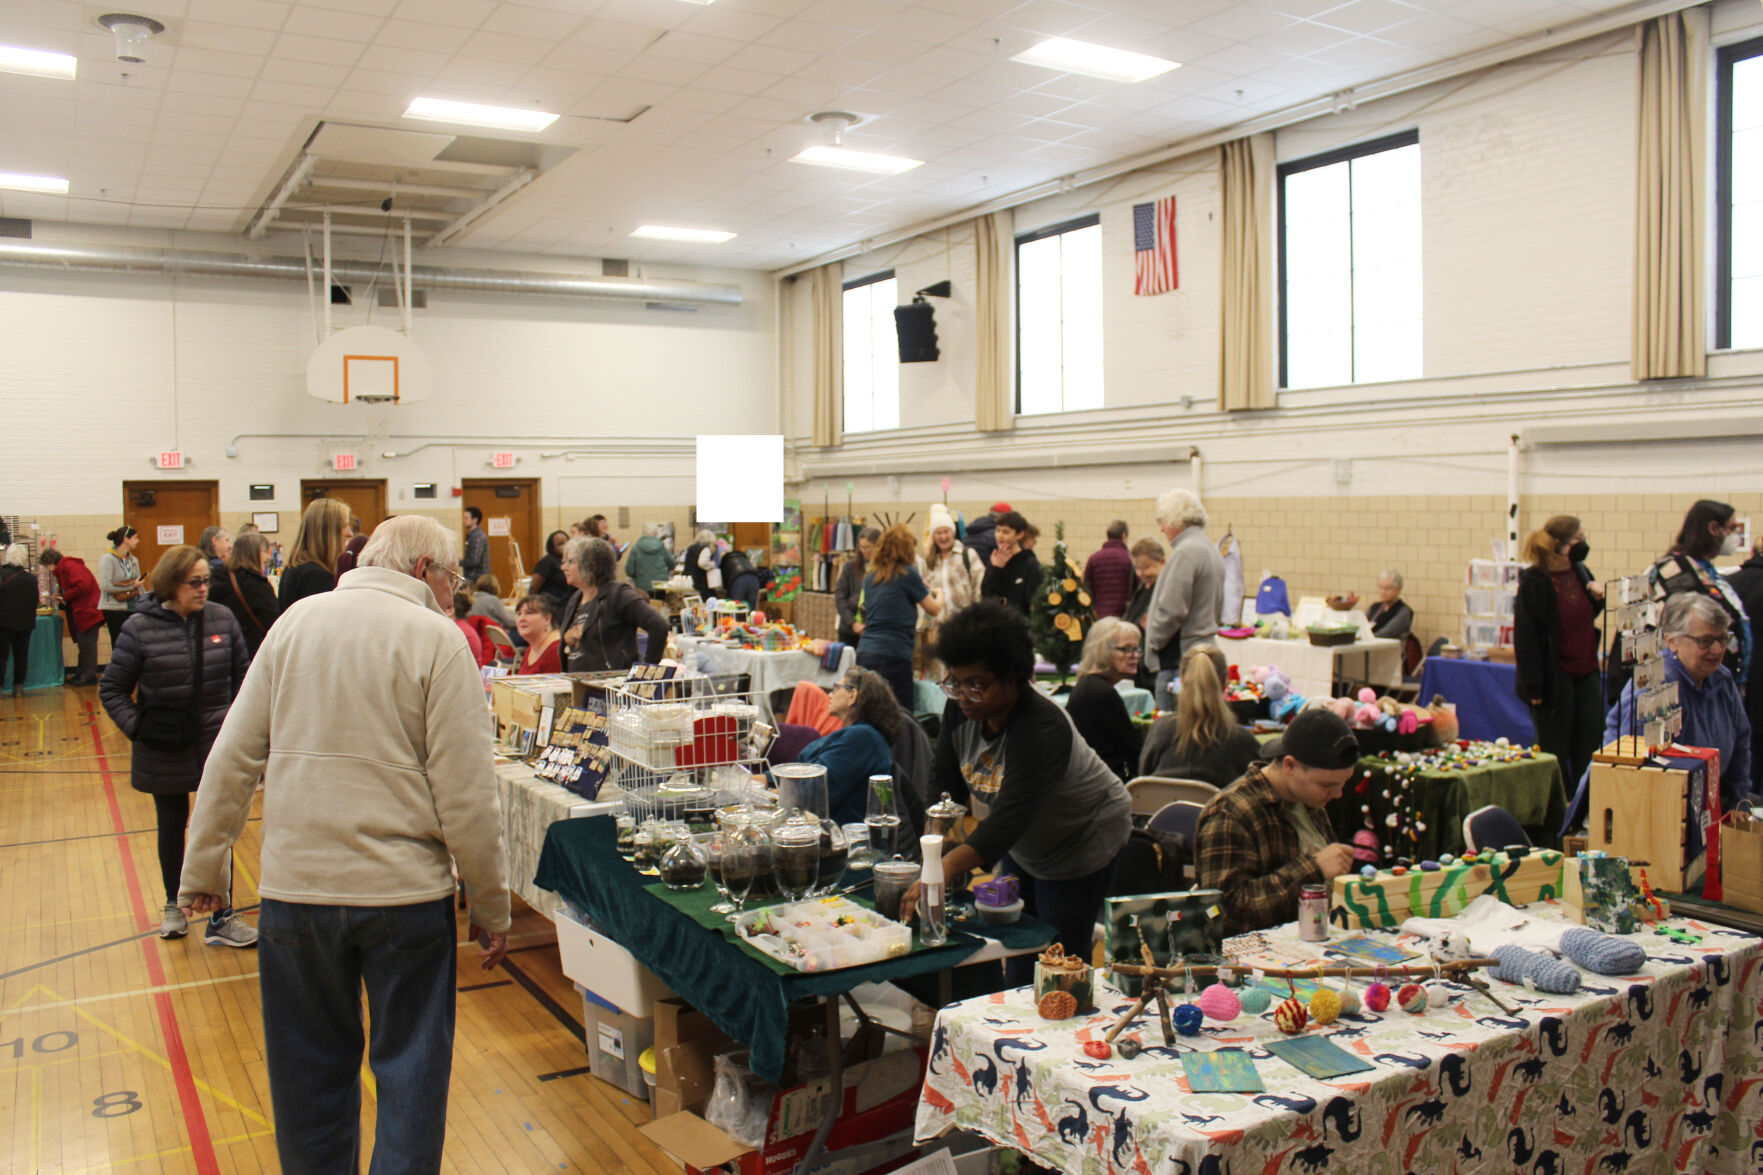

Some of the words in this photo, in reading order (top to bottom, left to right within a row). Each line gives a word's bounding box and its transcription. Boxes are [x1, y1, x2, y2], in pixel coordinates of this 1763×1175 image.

[161, 452, 181, 467] EXIT
[336, 454, 355, 469] EXIT
[496, 452, 513, 467] EXIT
[0, 1030, 79, 1059] 10
[91, 1090, 143, 1119] 8
